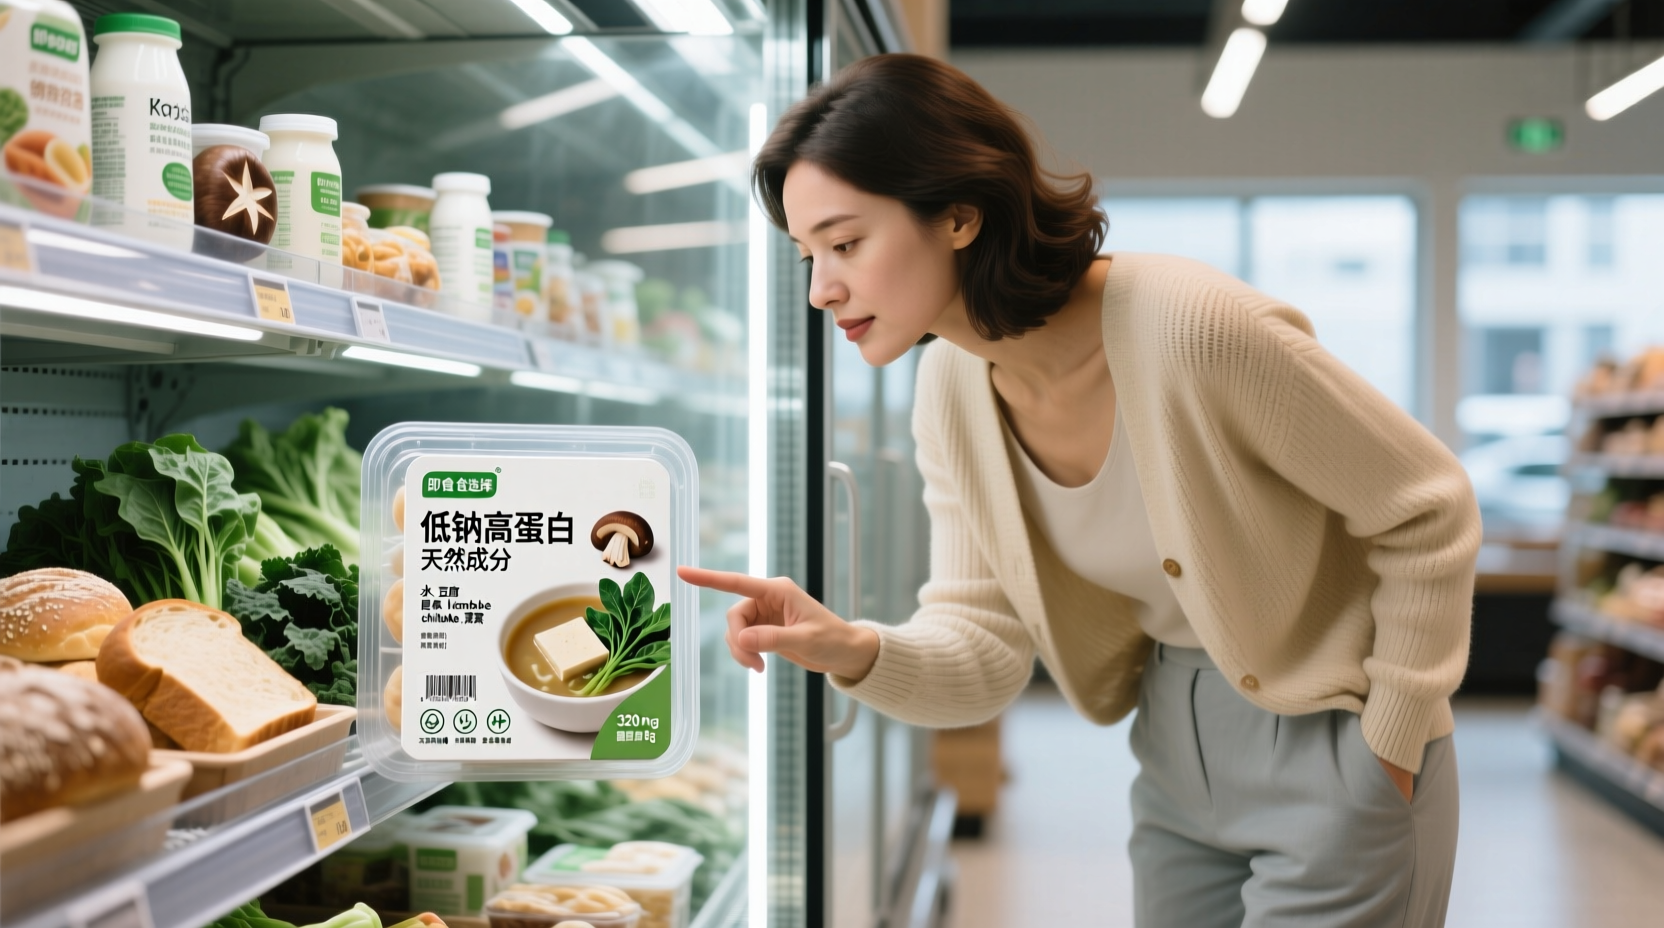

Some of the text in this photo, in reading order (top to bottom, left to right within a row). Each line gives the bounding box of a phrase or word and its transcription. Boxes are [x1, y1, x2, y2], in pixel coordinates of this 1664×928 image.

[420, 510, 574, 545] 低钠高蛋白
[421, 546, 512, 572] 天然成分
